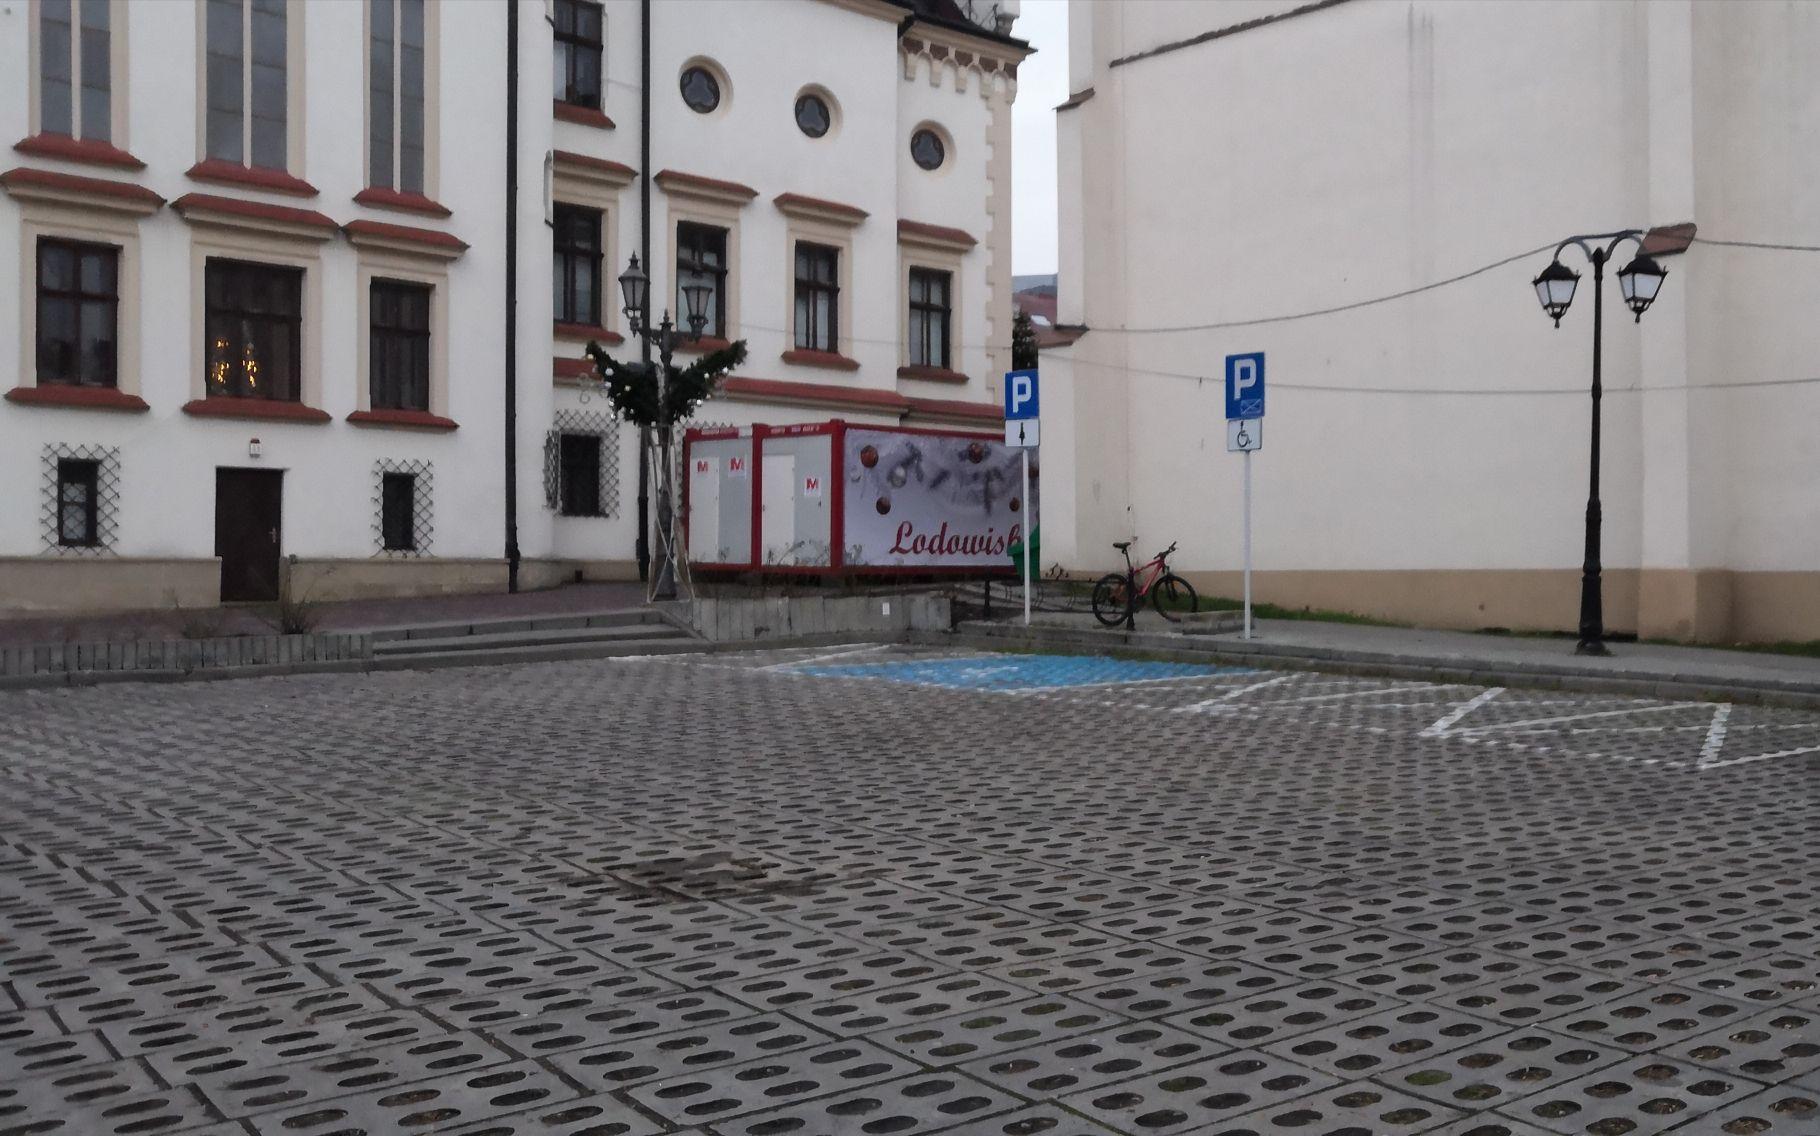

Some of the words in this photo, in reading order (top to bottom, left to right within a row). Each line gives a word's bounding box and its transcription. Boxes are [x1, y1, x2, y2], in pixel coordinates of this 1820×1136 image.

[1233, 358, 1257, 400] P
[1012, 376, 1032, 413] P
[697, 460, 709, 473] M
[729, 456, 744, 471] M
[806, 478, 819, 490] M
